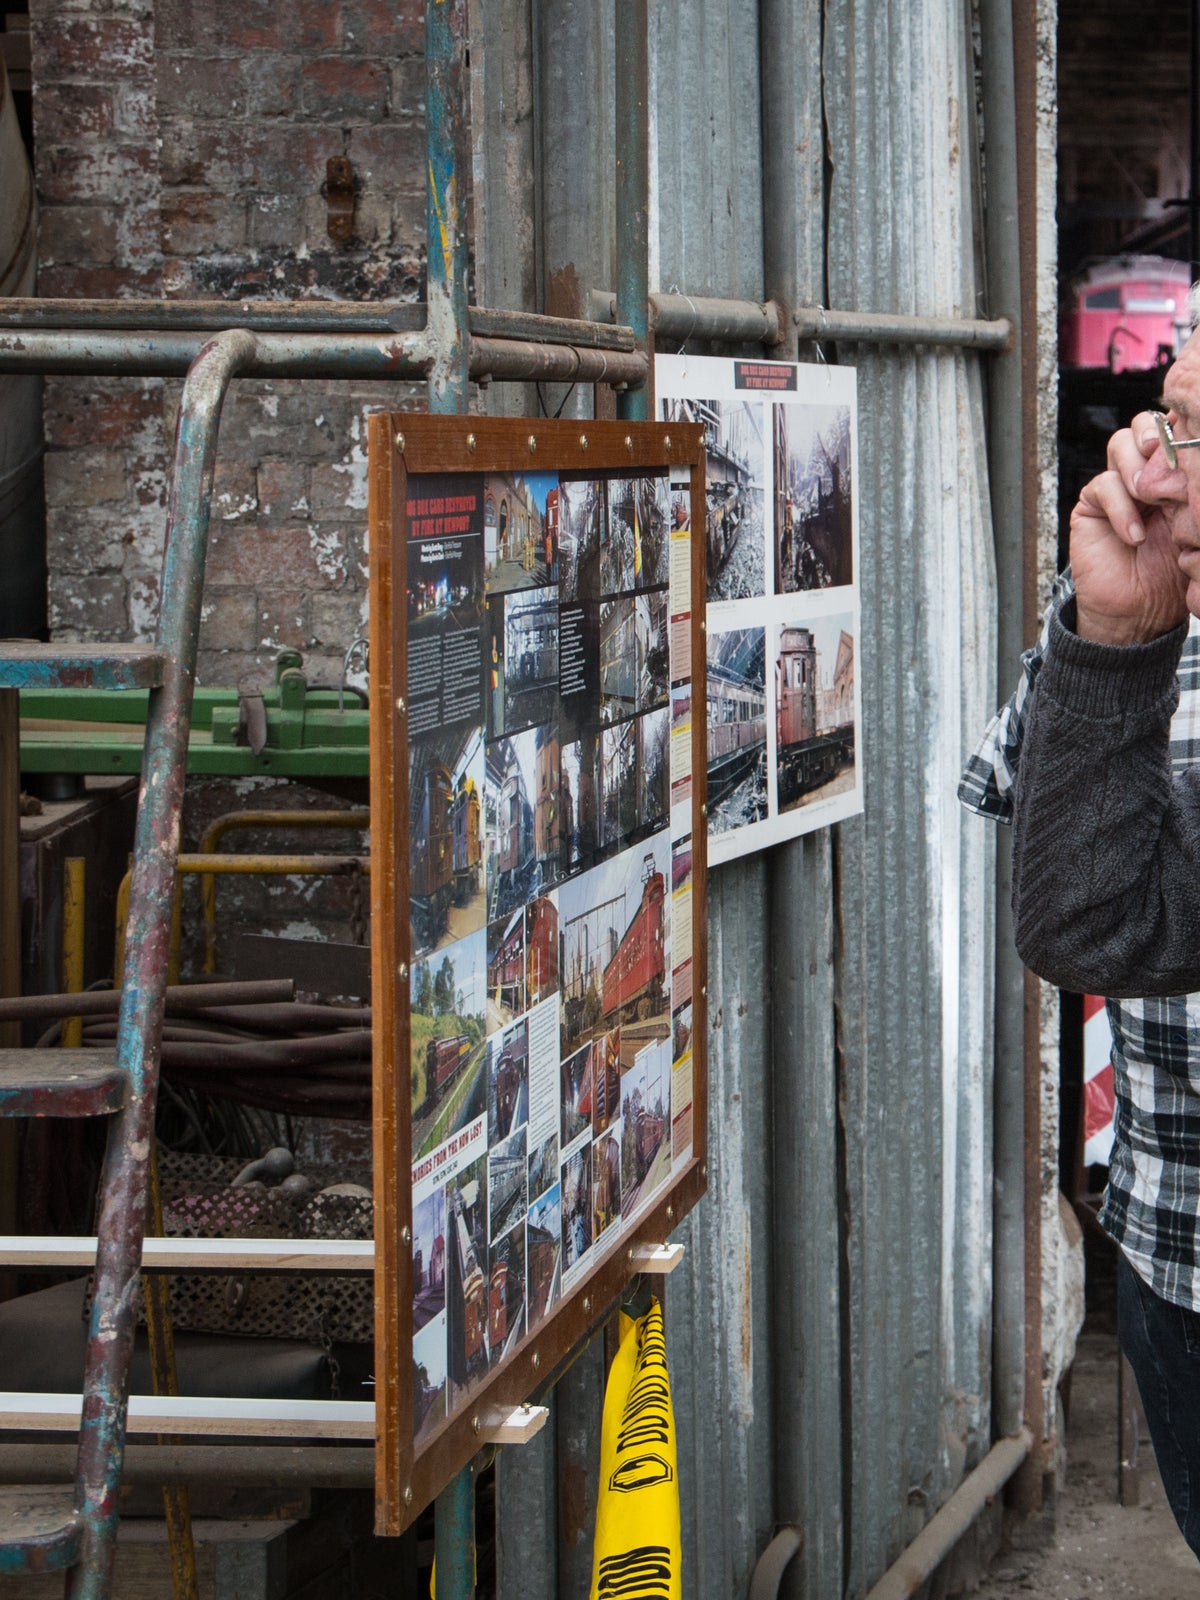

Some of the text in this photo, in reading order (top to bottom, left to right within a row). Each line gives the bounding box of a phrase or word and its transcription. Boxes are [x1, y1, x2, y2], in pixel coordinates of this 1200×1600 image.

[433, 1147, 446, 1168] FROM
[448, 1139, 458, 1158] THE
[459, 1131, 469, 1150] NOW
[470, 1120, 482, 1141] LOST
[616, 1414, 670, 1454] DO
